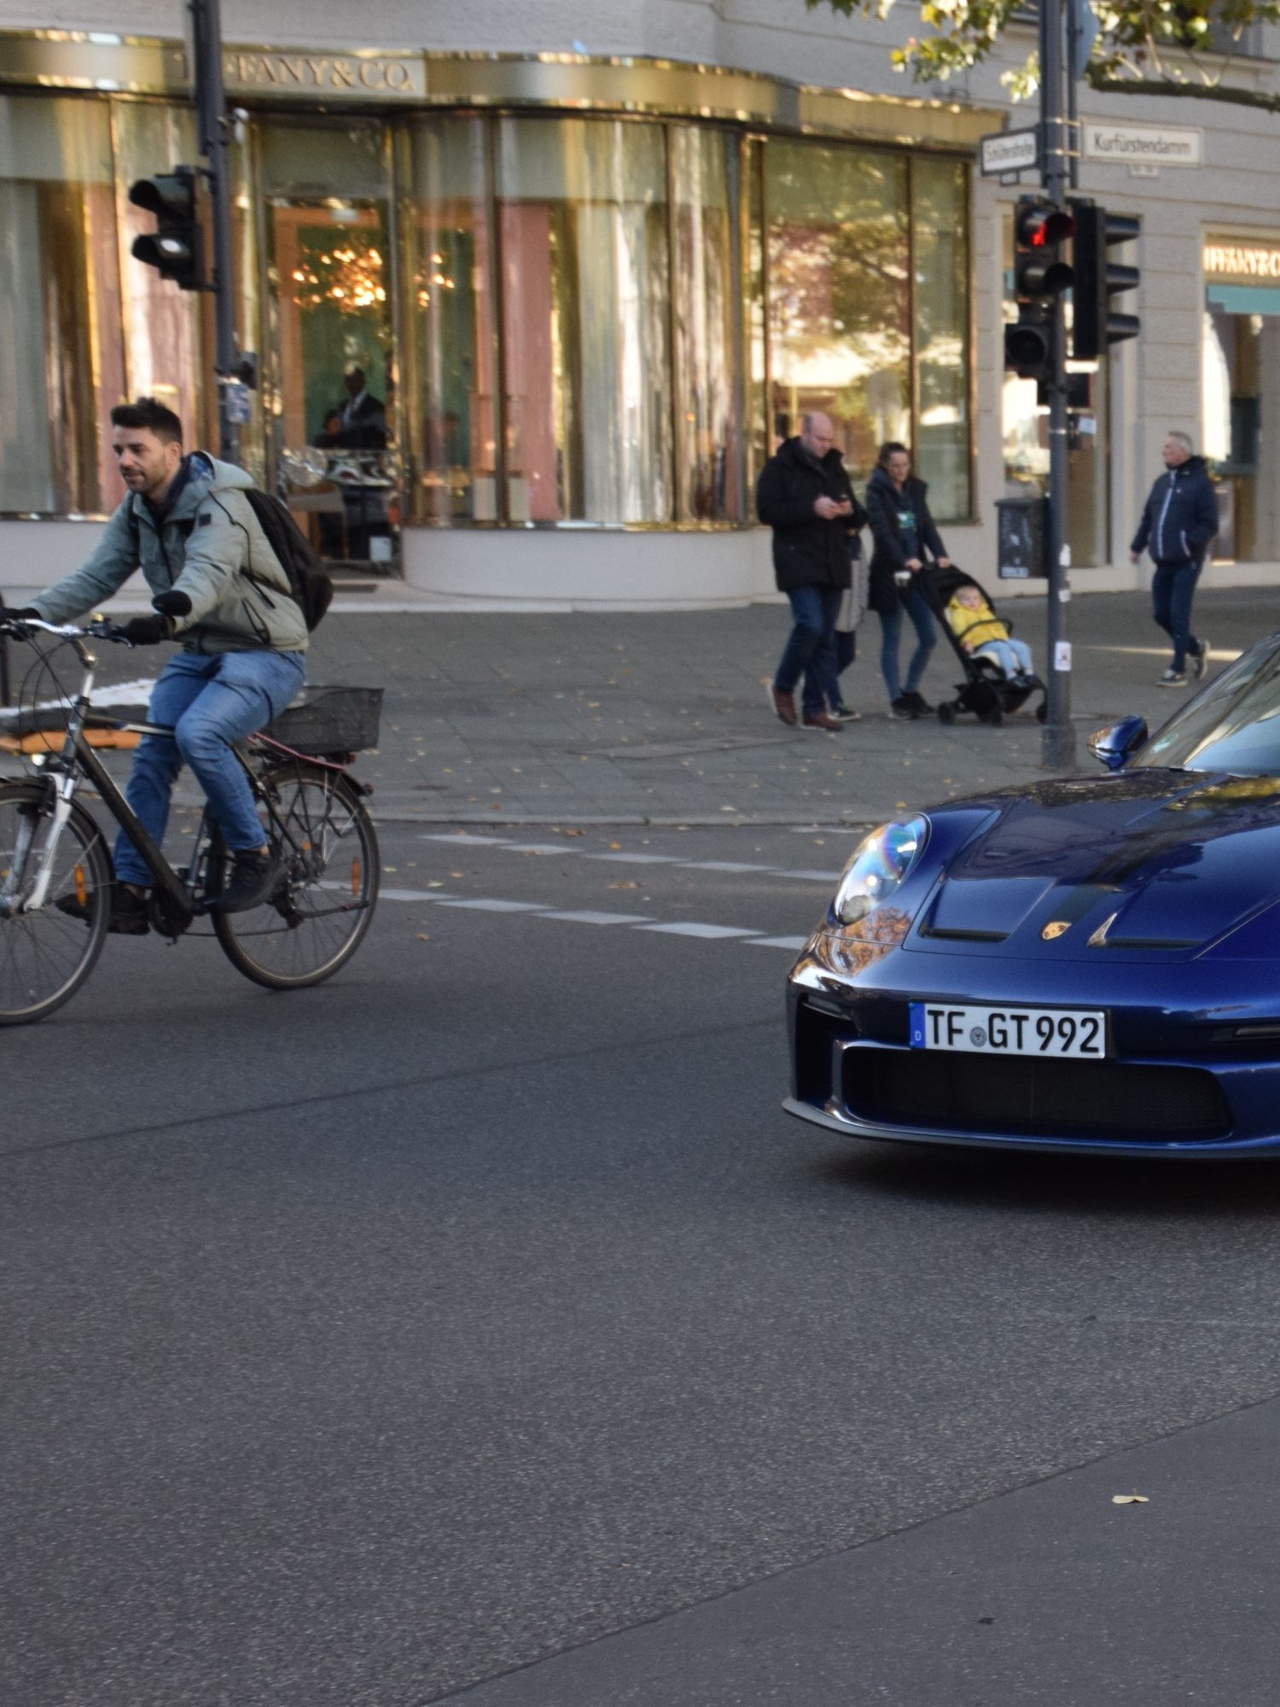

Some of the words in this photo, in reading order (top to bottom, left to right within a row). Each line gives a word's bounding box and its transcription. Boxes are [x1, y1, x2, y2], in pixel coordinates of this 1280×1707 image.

[1094, 131, 1192, 155] Kurfürstendamm
[914, 1030, 921, 1042] D
[927, 1009, 966, 1046] TF
[988, 1013, 1030, 1050] GT
[1036, 1016, 1100, 1053] 992
